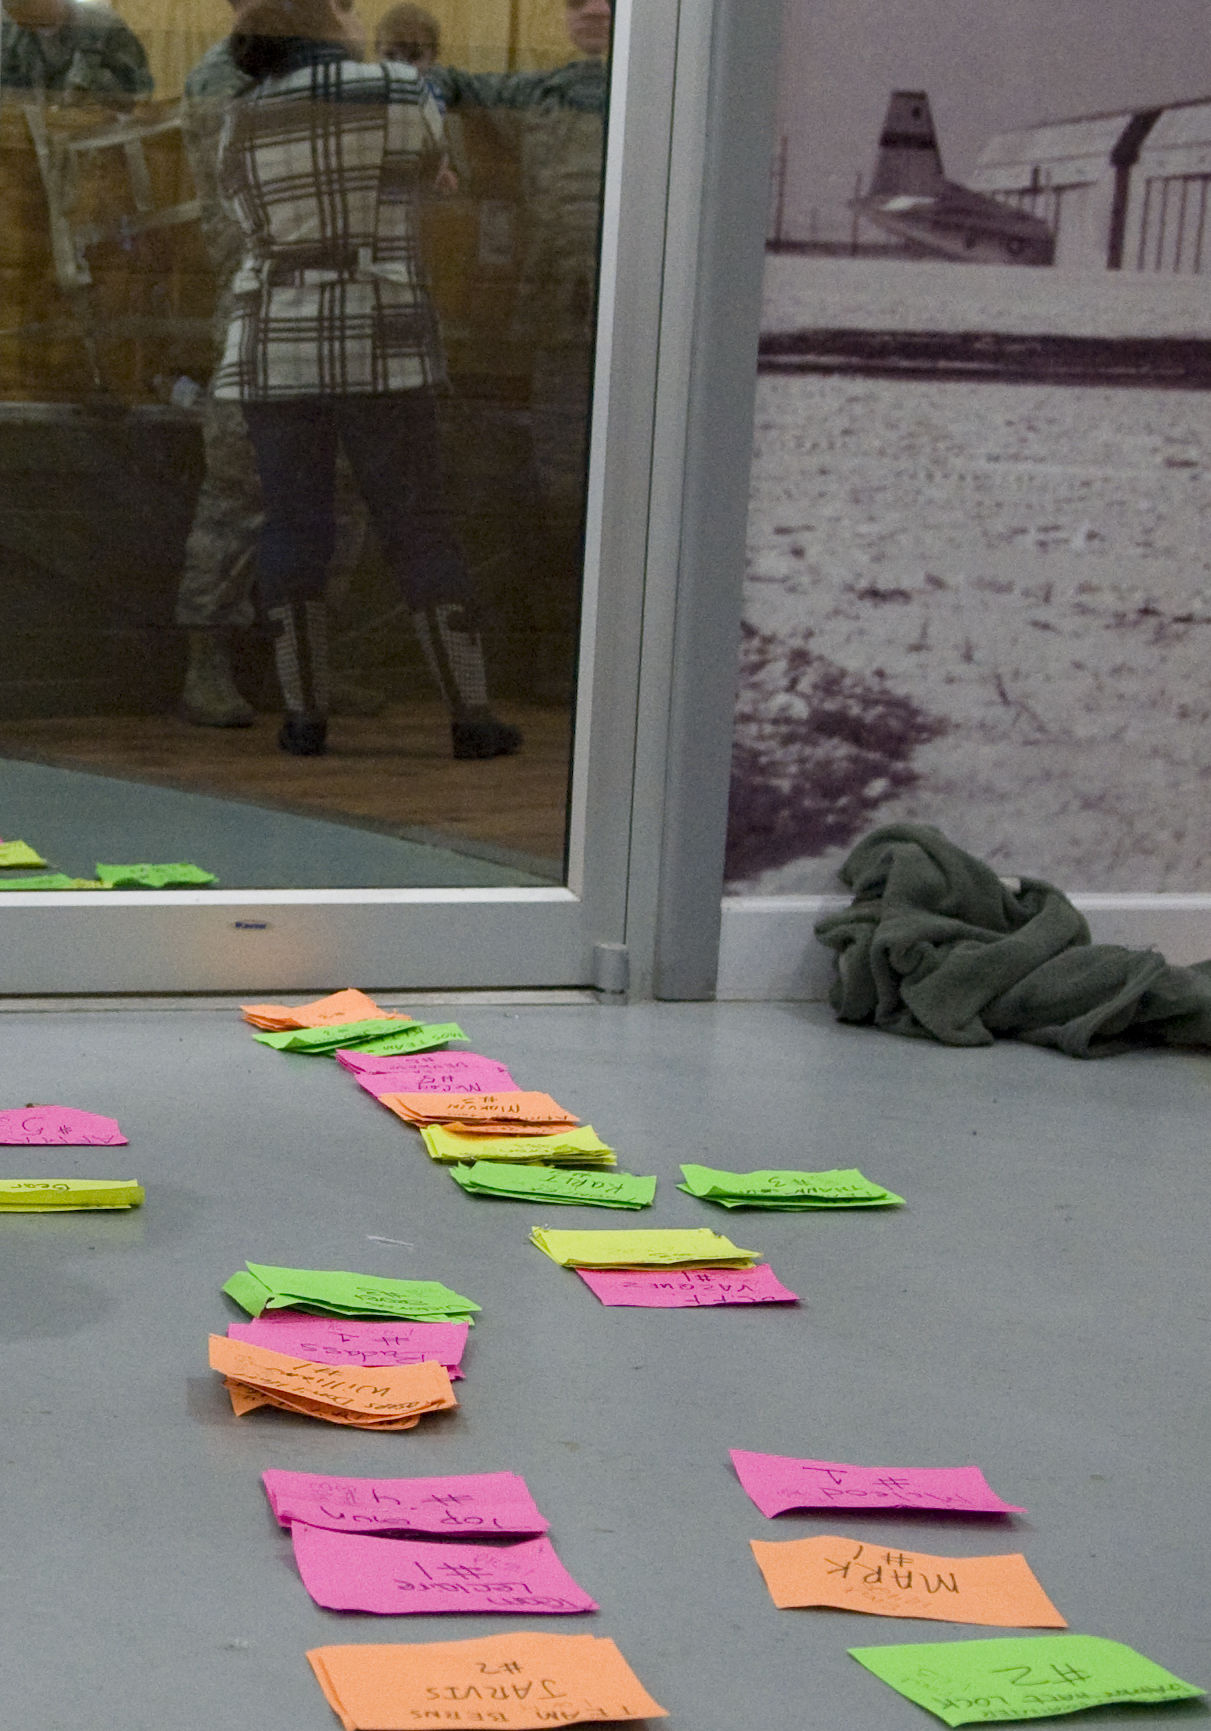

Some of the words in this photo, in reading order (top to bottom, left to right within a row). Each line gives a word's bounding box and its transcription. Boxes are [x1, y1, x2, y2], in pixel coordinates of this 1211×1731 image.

[852, 1545, 915, 1568] #1
[414, 1561, 494, 1581] #1
[824, 1557, 960, 1595] MARK
[475, 1661, 524, 1675] #2
[990, 1663, 1092, 1687] #2
[424, 1678, 568, 1701] JARVIS
